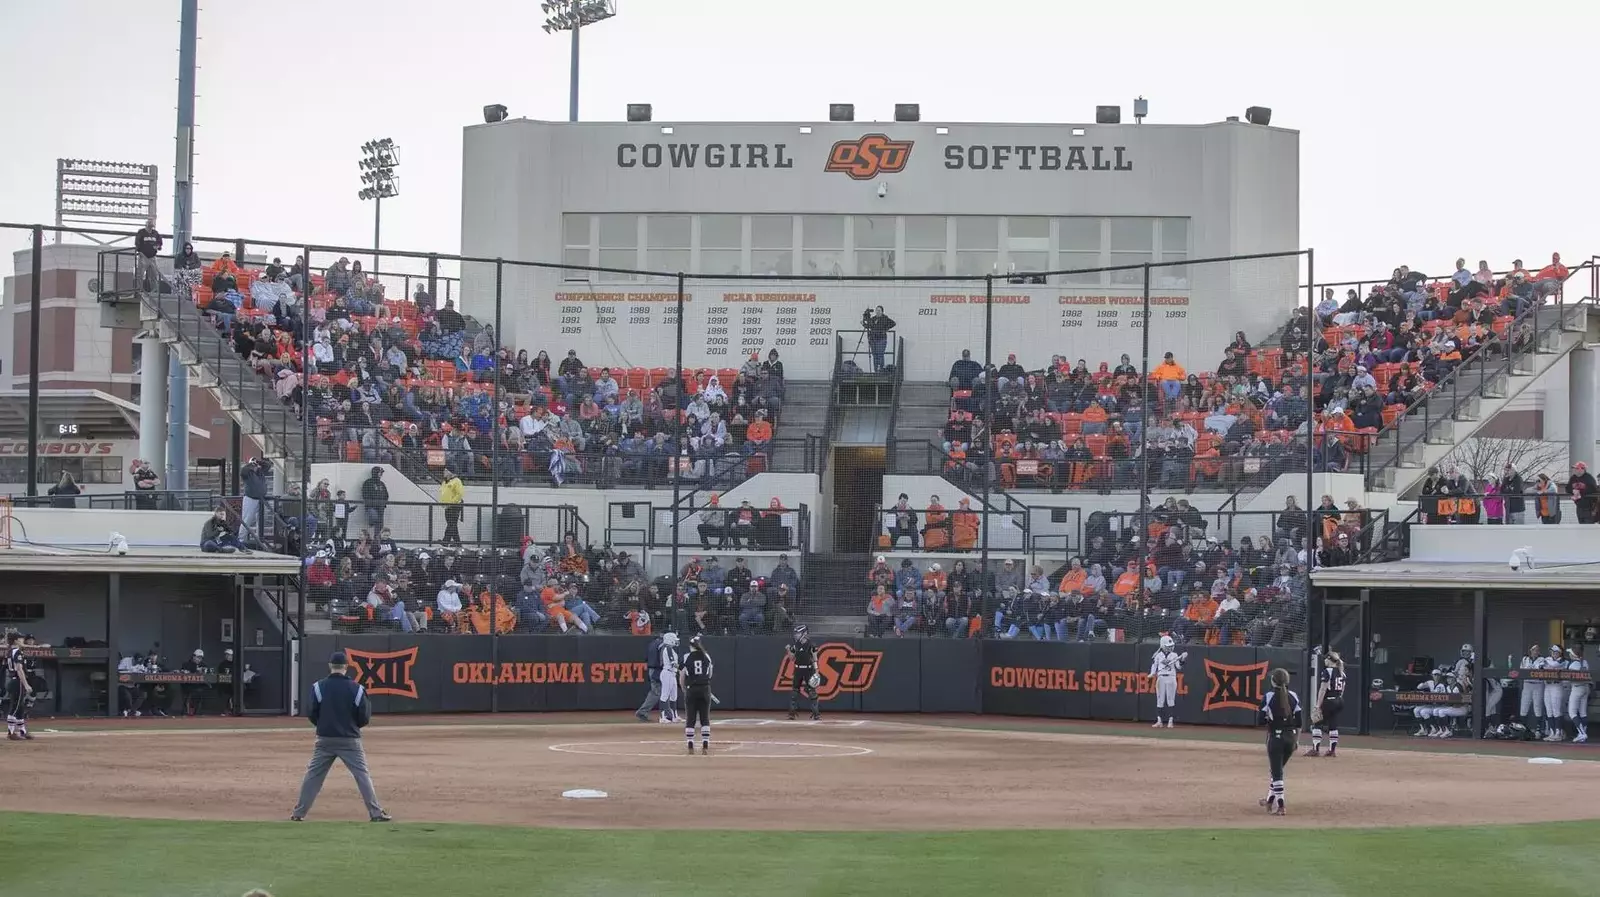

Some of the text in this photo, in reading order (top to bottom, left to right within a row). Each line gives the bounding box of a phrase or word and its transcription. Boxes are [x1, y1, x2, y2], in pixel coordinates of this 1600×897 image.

[616, 143, 793, 169] COWGIRL
[826, 134, 914, 180] OSU
[944, 144, 1133, 171] SOFTBALL
[555, 293, 693, 302] CONFERENCE CHAMPIOS
[723, 293, 817, 303] NCAA REGIONALS
[930, 294, 967, 304] SUPER
[1058, 296, 1107, 305] COLLEGE
[1149, 297, 1190, 306] SERIES
[560, 306, 685, 315] 1980 1981 1989 199
[707, 307, 832, 315] 1982 1984 1988 1989
[918, 307, 938, 316] 2011
[1061, 309, 1083, 318] 1982
[1096, 310, 1119, 318] 1989
[1165, 310, 1187, 319] 1993
[560, 316, 684, 325] 1991 1992 1993 199
[707, 317, 832, 325] 1990 1991 1992 1993
[1061, 319, 1083, 328] 1994
[560, 326, 582, 334] 1995
[707, 327, 833, 336] 1996 1997 1998 2003
[741, 337, 765, 346] 2009
[775, 338, 797, 346] 2010
[809, 338, 829, 346] 2011
[706, 347, 762, 355] 2016 2017
[59, 424, 78, 434] 6:15
[693, 660, 703, 675] 8
[453, 662, 647, 684] OKLAHOMA STAT
[144, 674, 205, 682] OKLAHOMA STATE
[991, 666, 1189, 695] COWGIRL SOFTBL
[1335, 677, 1343, 691] 15
[1395, 693, 1430, 701] OKLAHOMA
